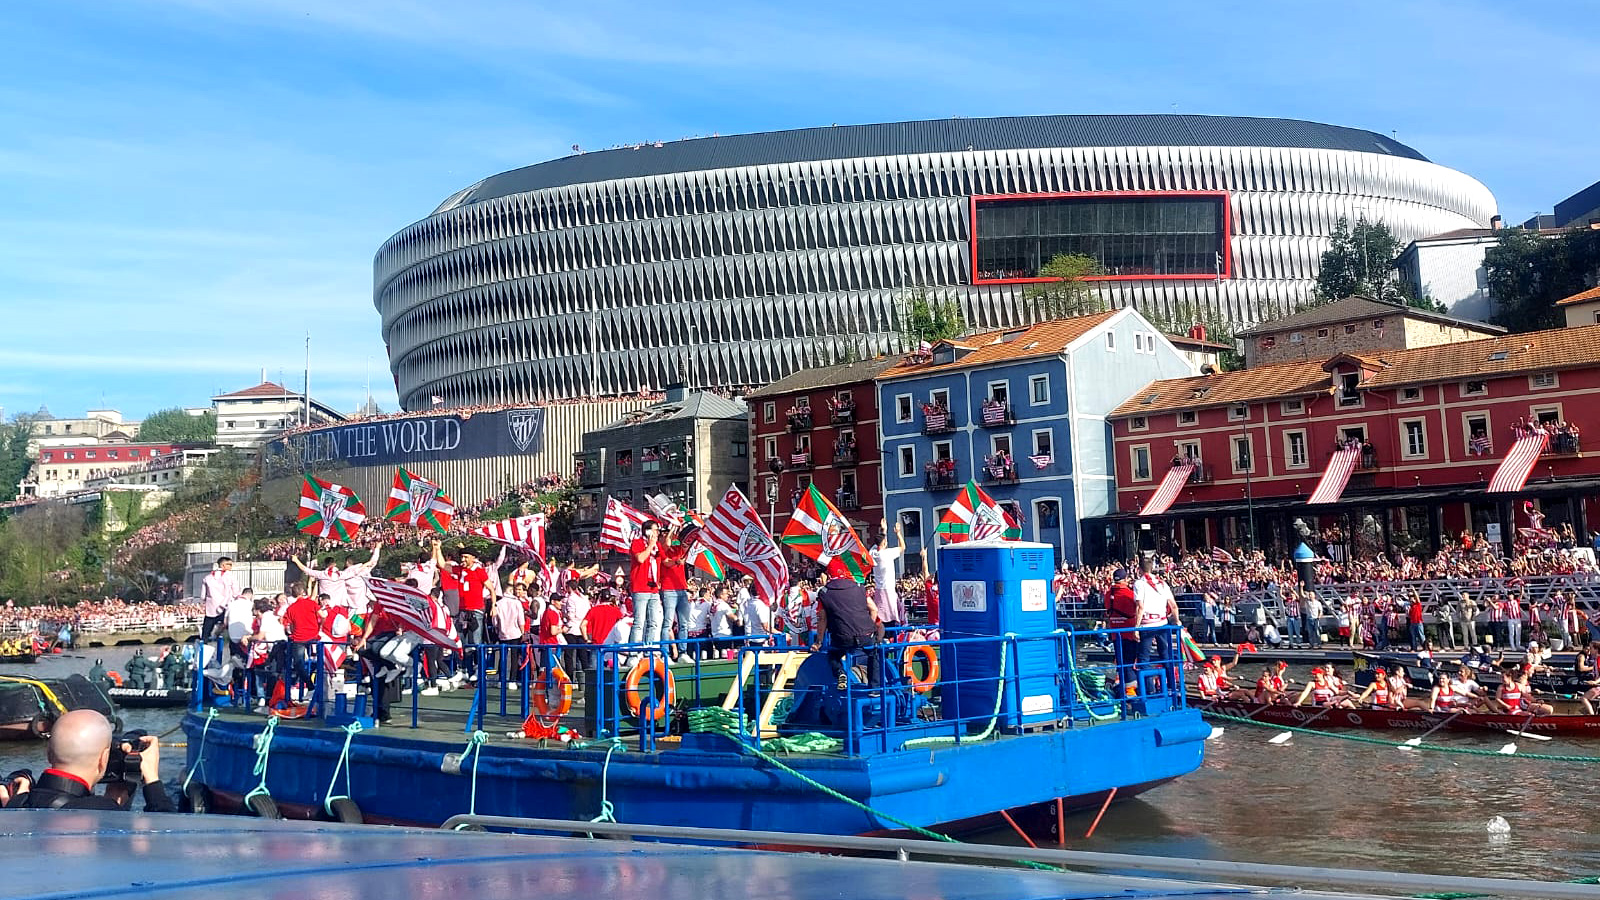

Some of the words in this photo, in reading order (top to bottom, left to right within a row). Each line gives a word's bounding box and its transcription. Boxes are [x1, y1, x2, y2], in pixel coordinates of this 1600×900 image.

[344, 425, 377, 458] THE
[382, 418, 461, 453] WORLD
[108, 688, 144, 696] GUARDIA
[146, 689, 169, 697] CIVIL
